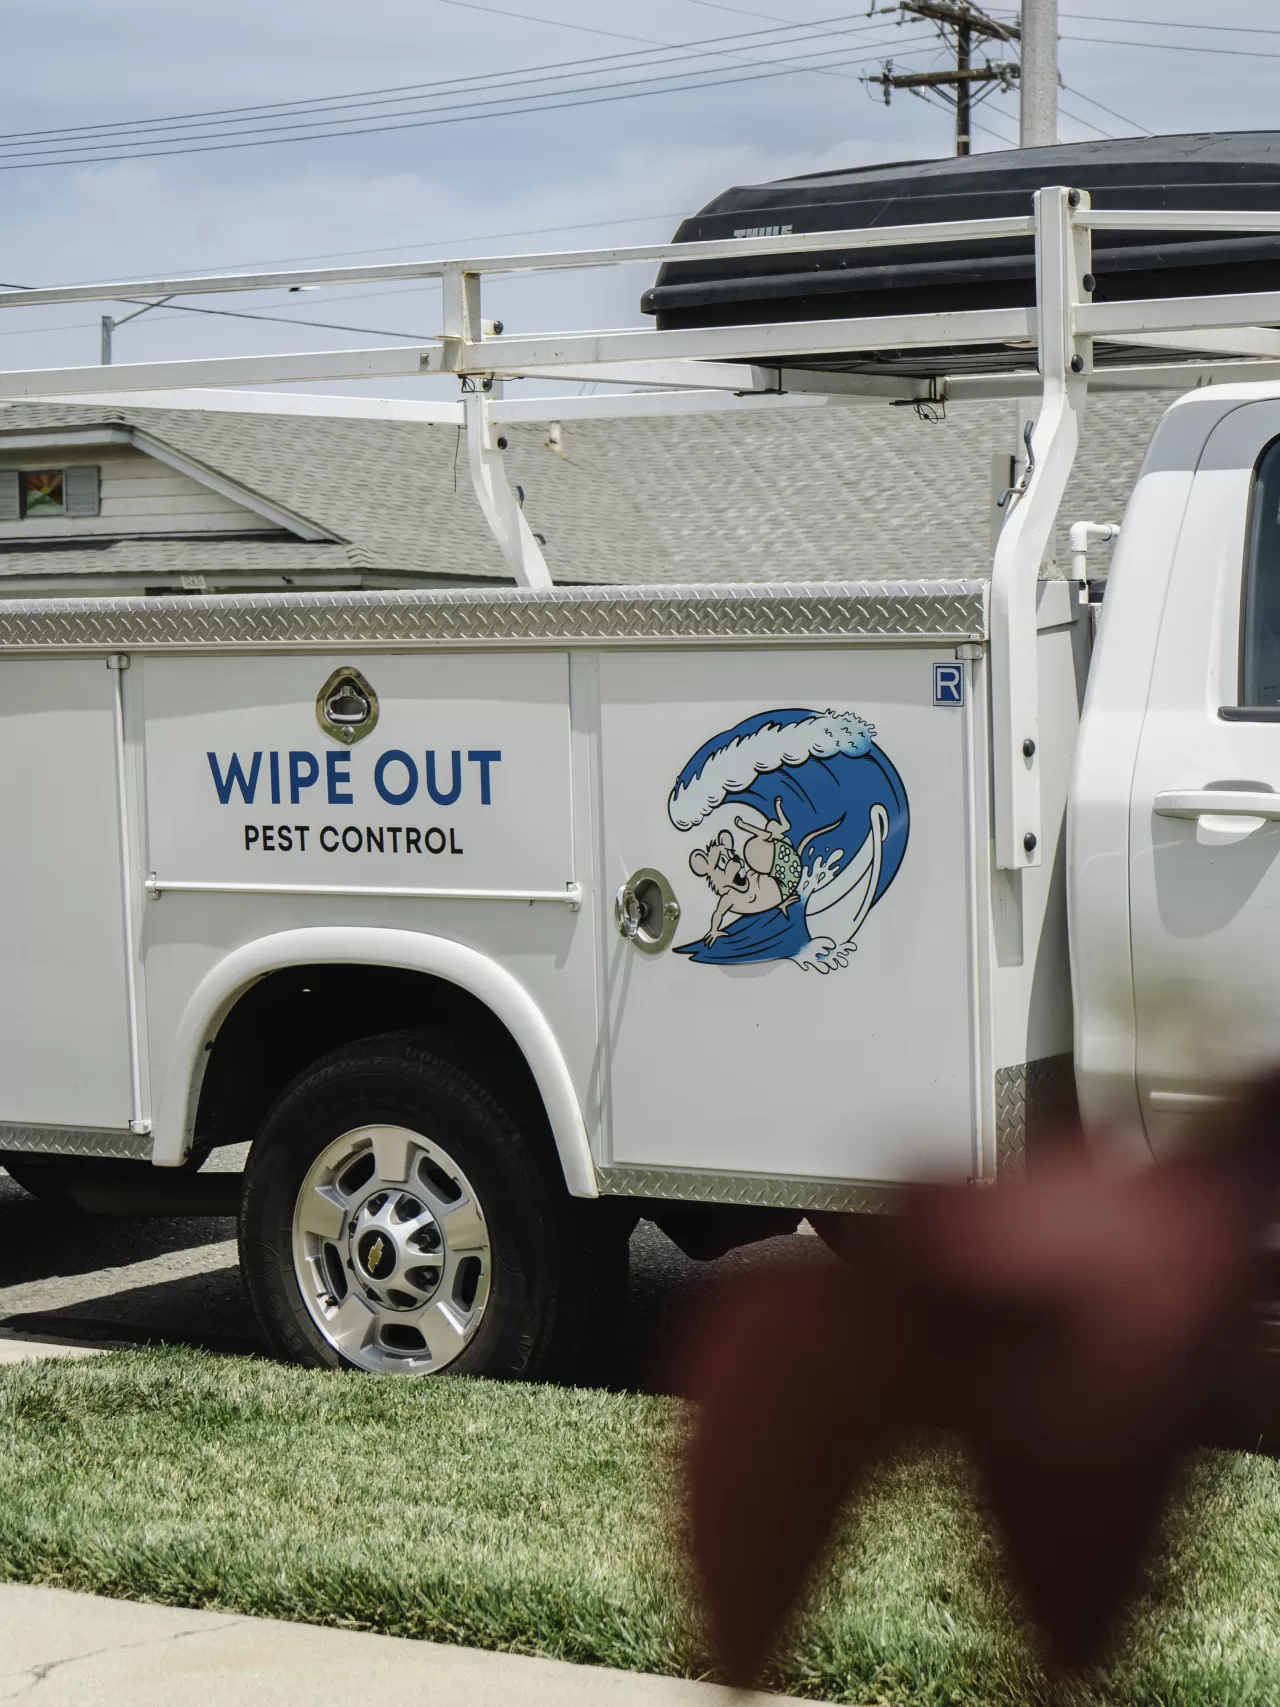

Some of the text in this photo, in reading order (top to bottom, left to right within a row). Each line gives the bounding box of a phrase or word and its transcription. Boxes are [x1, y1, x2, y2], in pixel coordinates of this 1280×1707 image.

[936, 667, 960, 700] R
[206, 749, 502, 806] WIPE OUT
[244, 825, 464, 855] PEST CONTROL
